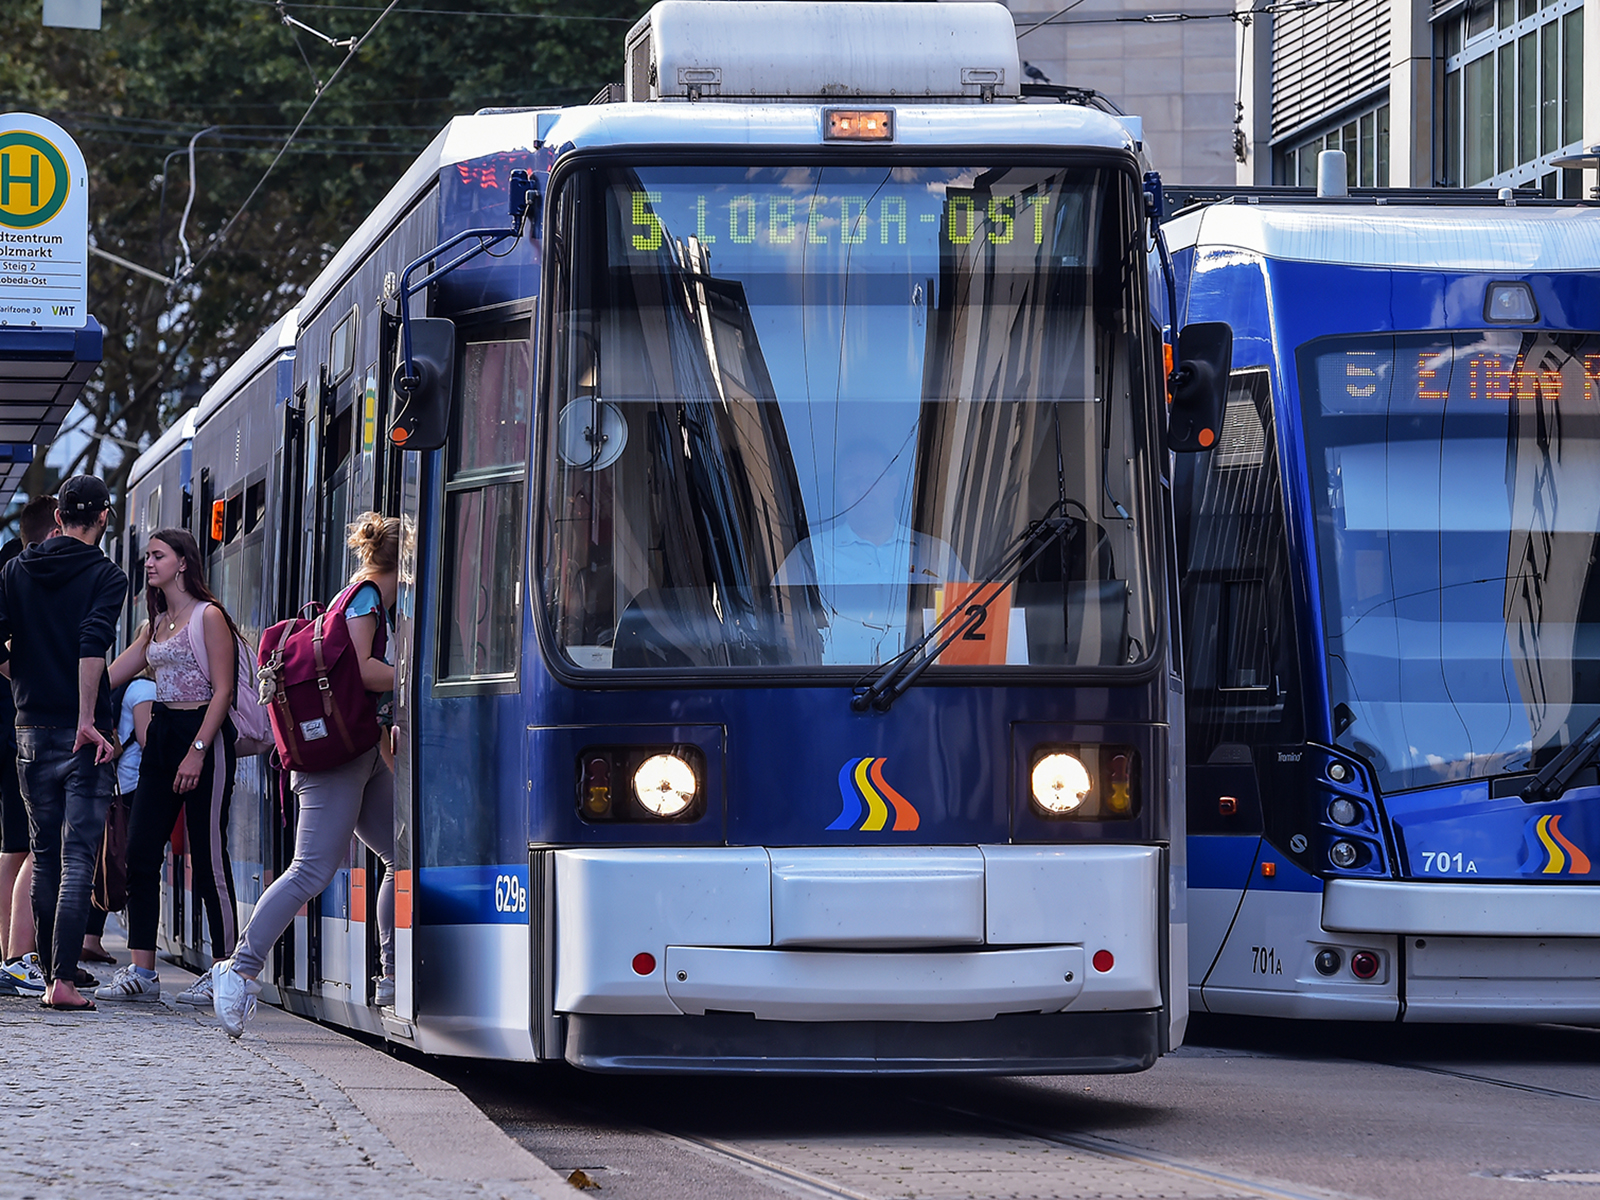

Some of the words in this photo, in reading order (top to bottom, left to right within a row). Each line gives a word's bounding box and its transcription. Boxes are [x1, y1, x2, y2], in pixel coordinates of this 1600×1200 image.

[1, 153, 39, 207] H
[631, 191, 662, 251] 5
[696, 195, 1050, 245] LOBEDA-OST
[0, 275, 47, 285] obeda-Ost
[3, 261, 27, 273] Steig
[30, 262, 36, 271] 2
[0, 305, 31, 314] arifzone
[32, 306, 42, 314] 30
[51, 305, 75, 316] VMT
[962, 604, 988, 641] 2
[1421, 851, 1478, 874] 701A
[495, 874, 527, 913] 629B
[1251, 946, 1283, 975] 701A
